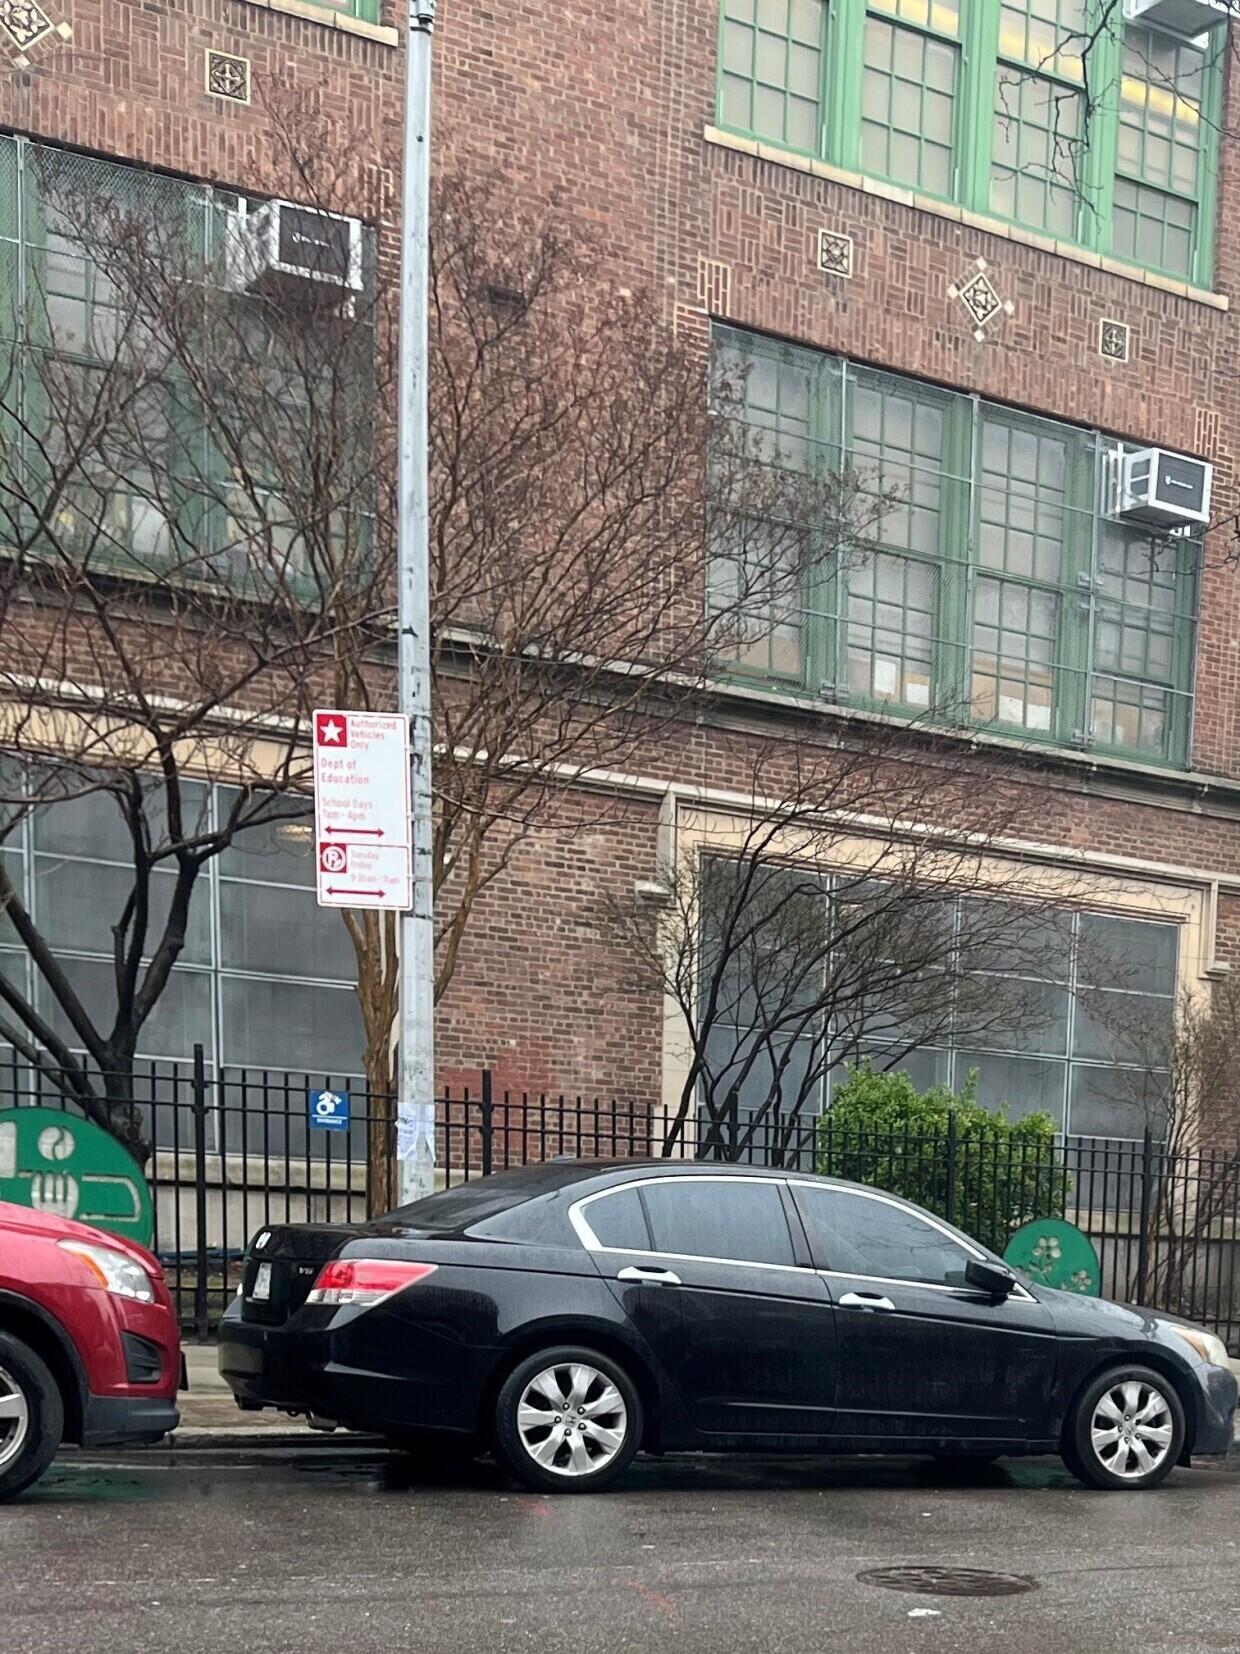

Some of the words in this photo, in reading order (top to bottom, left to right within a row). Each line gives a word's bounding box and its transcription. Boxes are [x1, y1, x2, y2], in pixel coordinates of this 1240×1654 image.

[351, 719, 397, 730] Authorized
[351, 730, 385, 740] Vehicles
[351, 740, 369, 751] Only
[321, 758, 344, 770] Dept
[347, 759, 356, 769] of
[321, 774, 369, 785] Education
